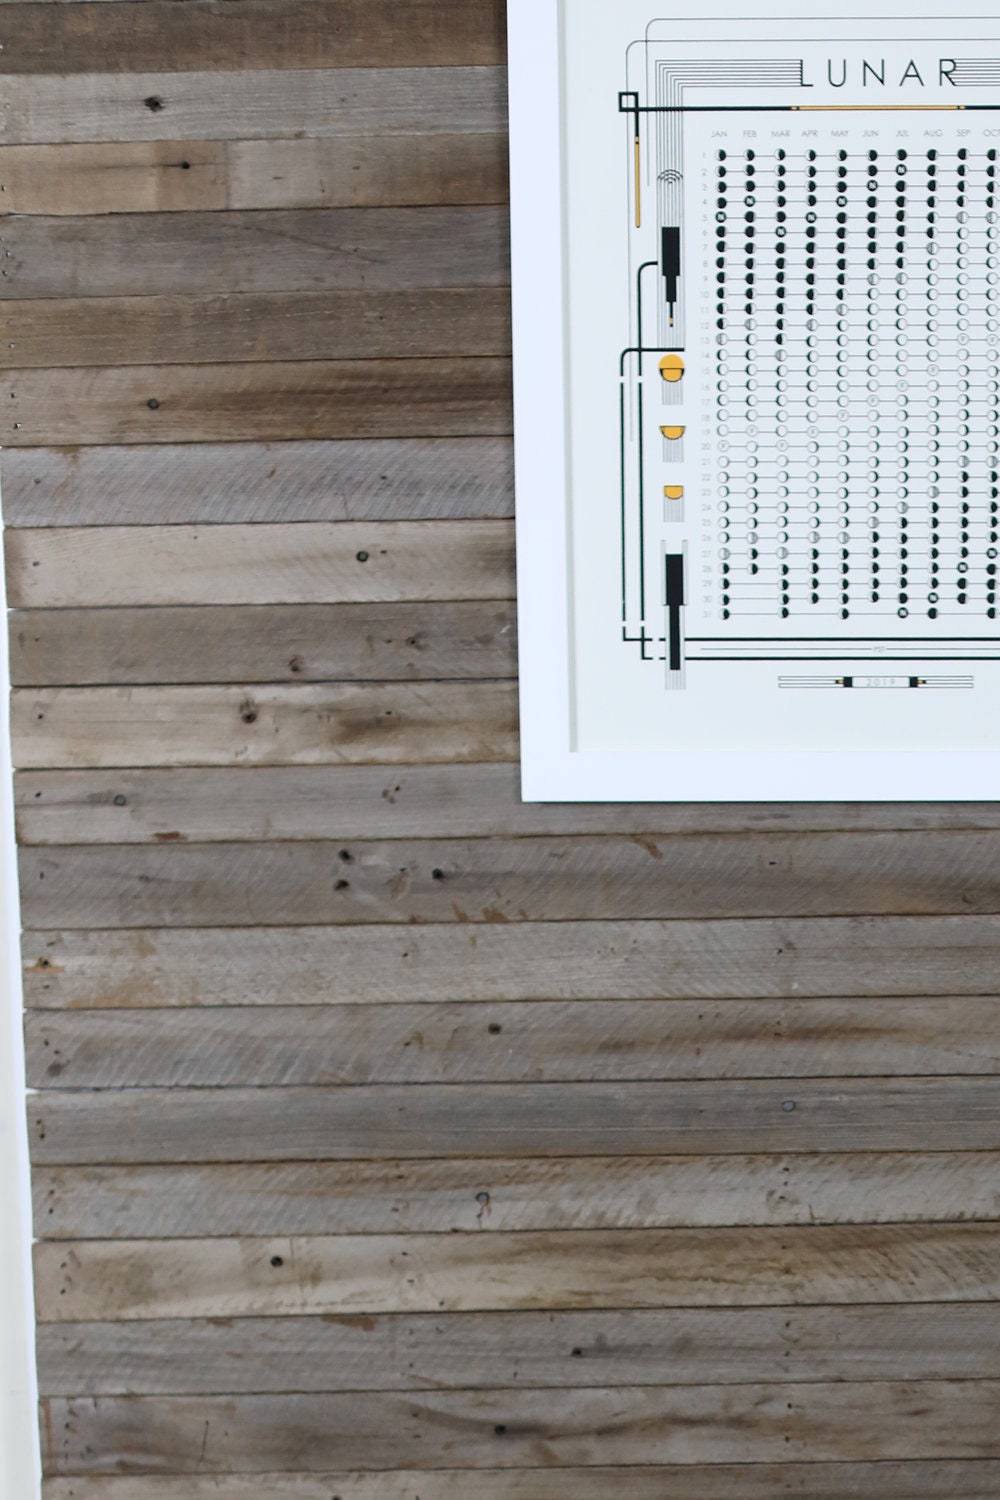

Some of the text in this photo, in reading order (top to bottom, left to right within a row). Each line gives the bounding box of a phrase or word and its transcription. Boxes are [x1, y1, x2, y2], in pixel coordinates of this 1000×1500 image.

[800, 58, 958, 87] LUNAR
[711, 130, 728, 138] JAN
[743, 130, 758, 138] FEB
[771, 130, 790, 138] MAR
[801, 130, 818, 138] APR
[831, 130, 849, 138] MAY
[862, 130, 879, 138] JUN
[865, 678, 896, 687] 2019
